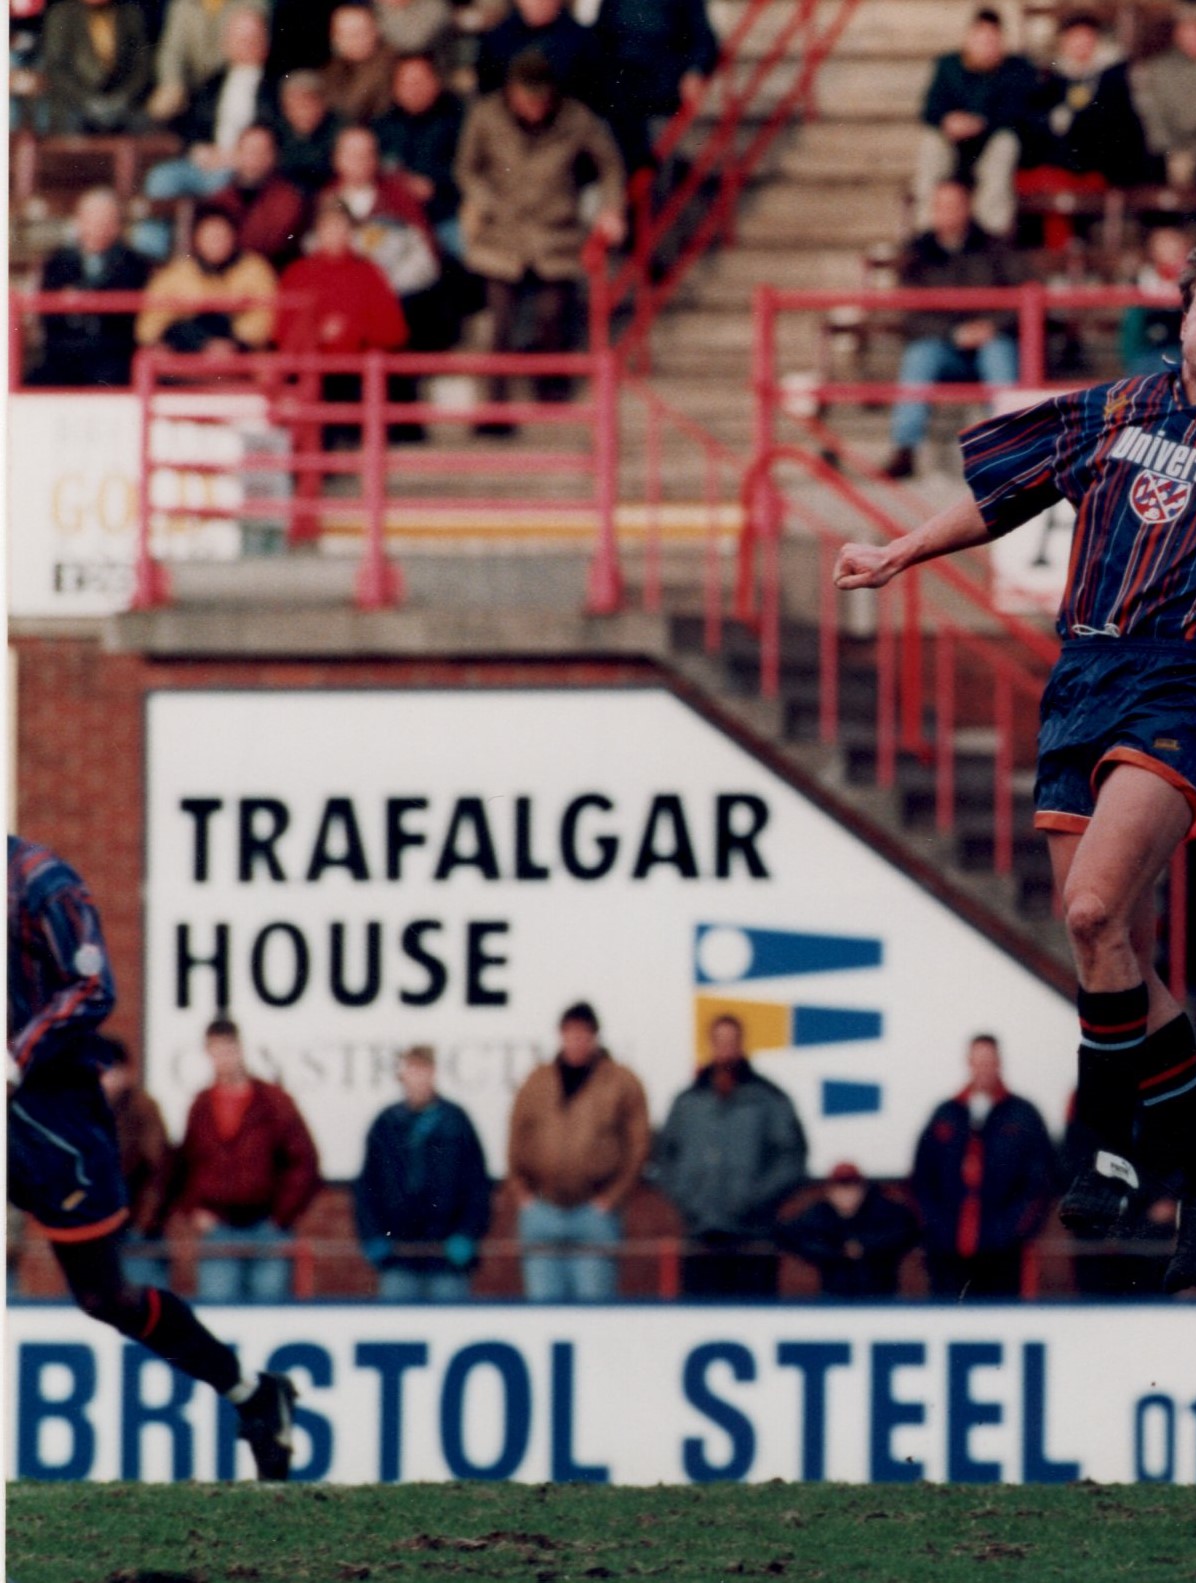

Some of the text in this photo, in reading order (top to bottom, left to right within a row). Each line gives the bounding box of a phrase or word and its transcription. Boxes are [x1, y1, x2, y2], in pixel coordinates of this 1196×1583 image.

[180, 795, 774, 882] TRAFALGAR
[176, 920, 510, 1008] HOUSE
[16, 1341, 610, 1483] BRISTOL
[683, 1341, 1081, 1483] STEEL
